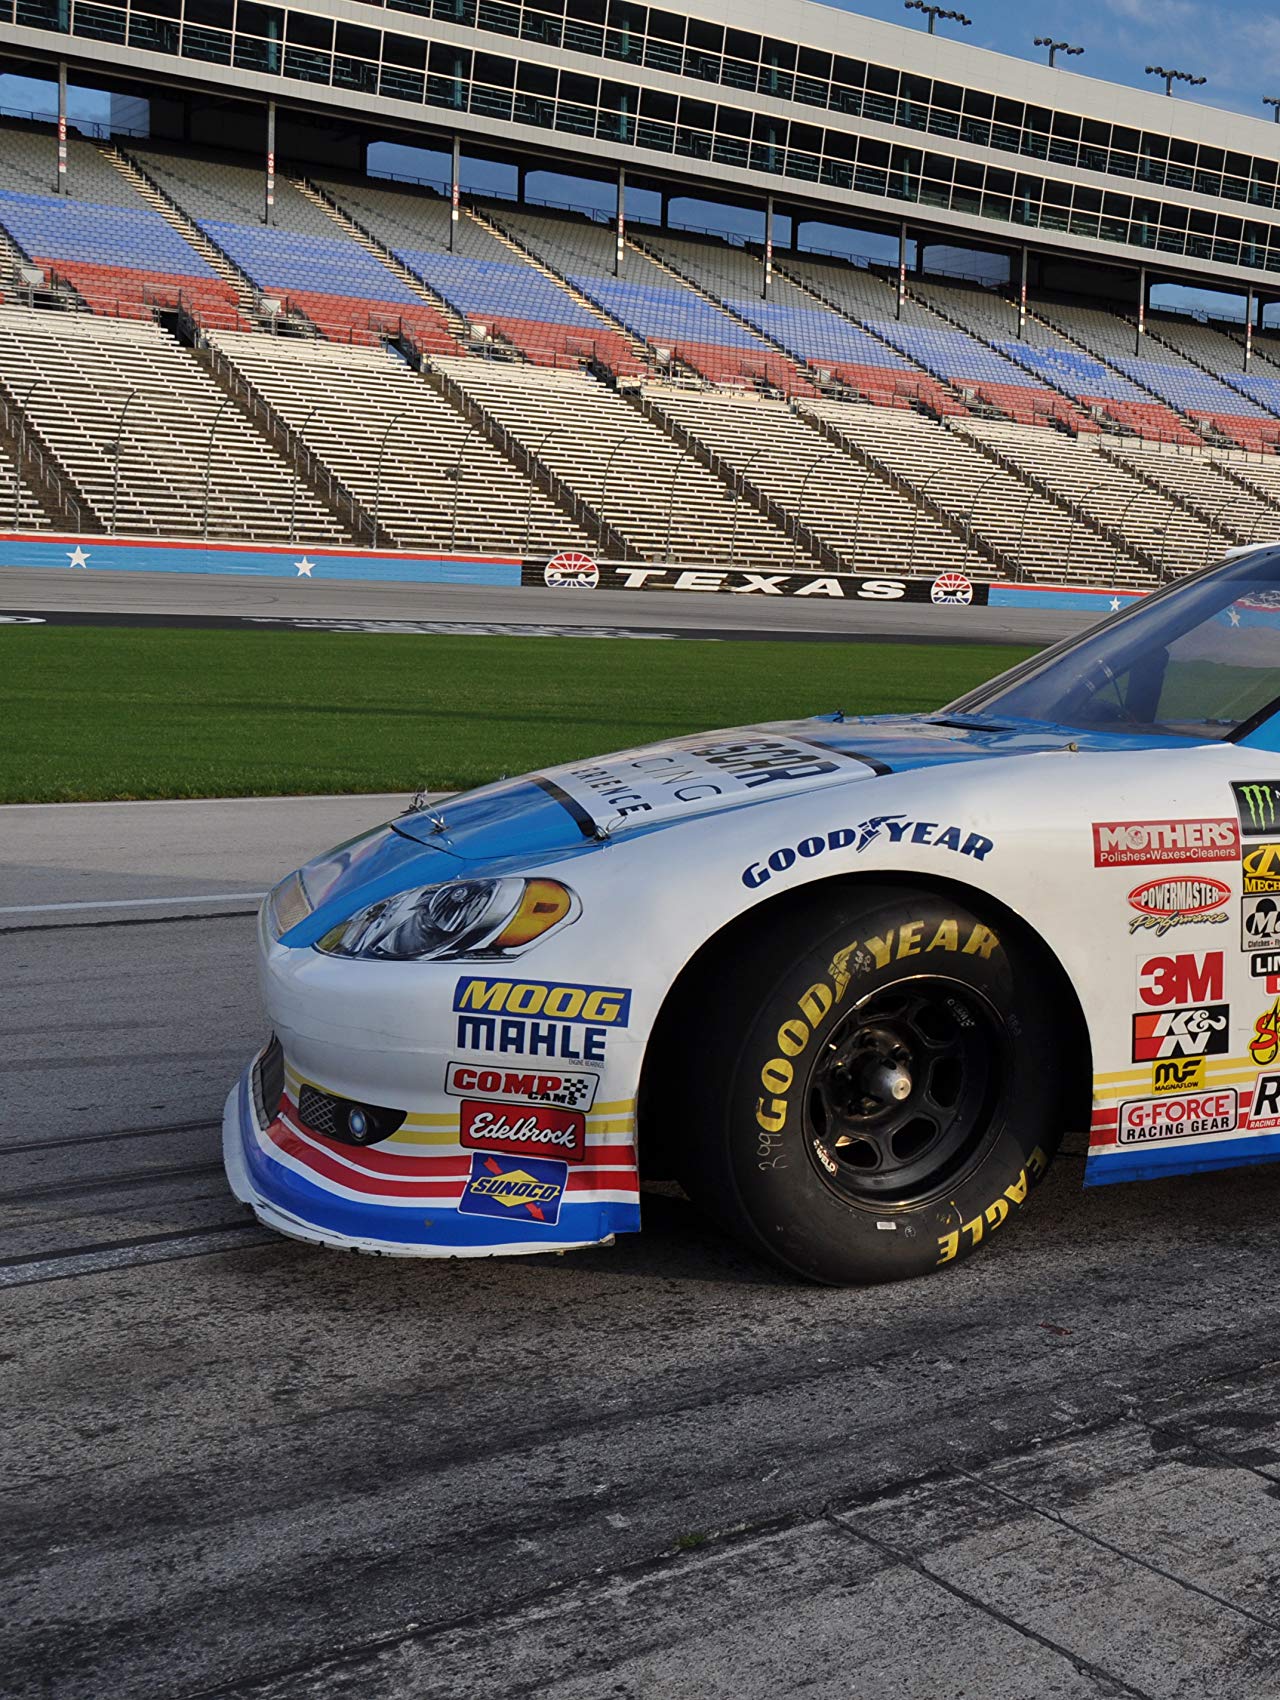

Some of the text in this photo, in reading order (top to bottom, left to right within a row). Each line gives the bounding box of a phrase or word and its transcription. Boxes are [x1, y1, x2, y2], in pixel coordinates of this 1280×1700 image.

[615, 568, 906, 599] TEXAS
[1099, 822, 1236, 851] MOTHERS
[741, 818, 994, 889] GOODYEAR
[1140, 881, 1219, 910] POWERMASTER
[1129, 911, 1229, 937] Performance
[1139, 951, 1224, 1006] 3M
[459, 981, 625, 1022] MOOG
[457, 1015, 607, 1061] MAHLE
[453, 1069, 562, 1095] COMP
[1154, 1082, 1199, 1092] MAGNAFLOW
[527, 1091, 578, 1106] CAMS
[1127, 1095, 1230, 1127] G-FORCE
[469, 1112, 576, 1148] Edelbrock
[1127, 1116, 1229, 1140] RACING GEAR
[1249, 1118, 1276, 1128] RACING
[473, 1178, 560, 1201] SUNOCO
[936, 1145, 1048, 1265] EAGLE
